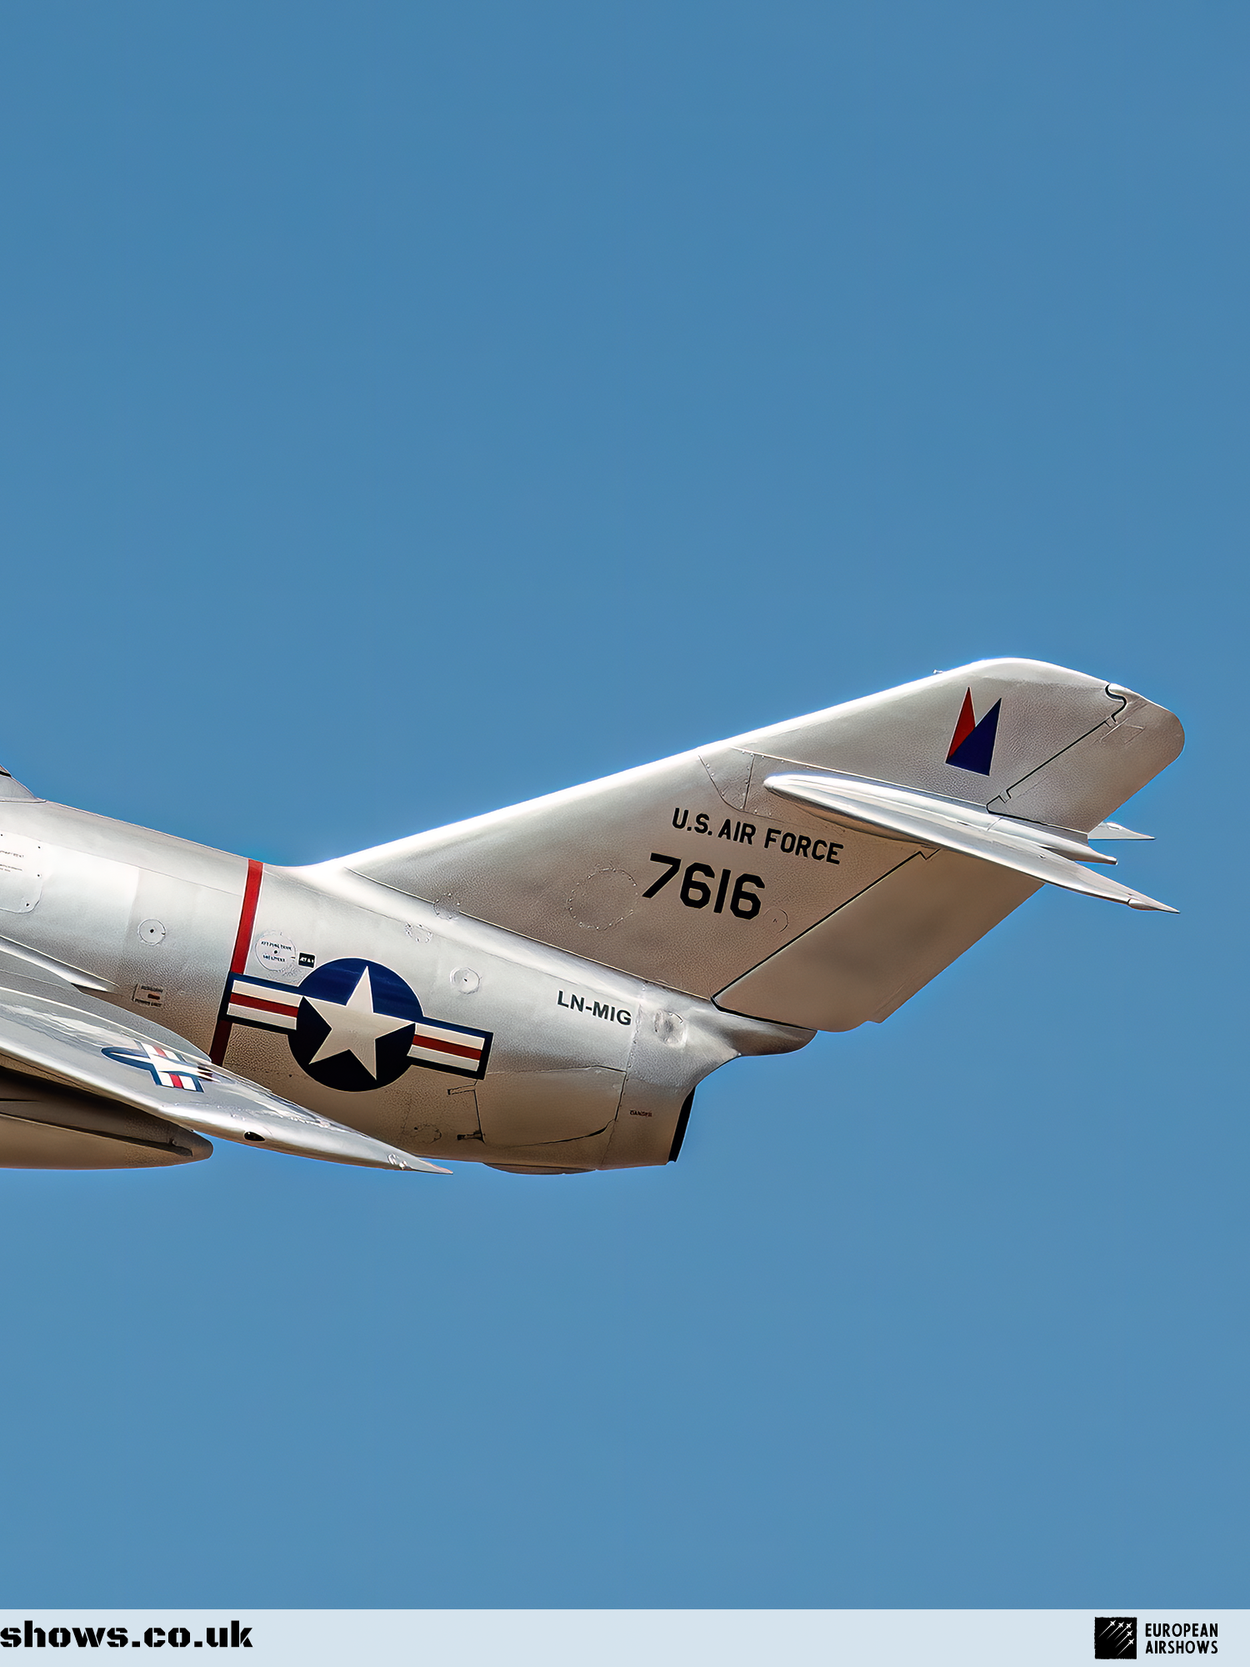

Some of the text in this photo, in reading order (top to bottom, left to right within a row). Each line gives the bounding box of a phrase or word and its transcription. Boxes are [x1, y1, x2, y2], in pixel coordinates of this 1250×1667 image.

[671, 807, 845, 866] U.S. AIR FORCE
[641, 852, 766, 920] 7616
[556, 989, 633, 1026] LN-MIG
